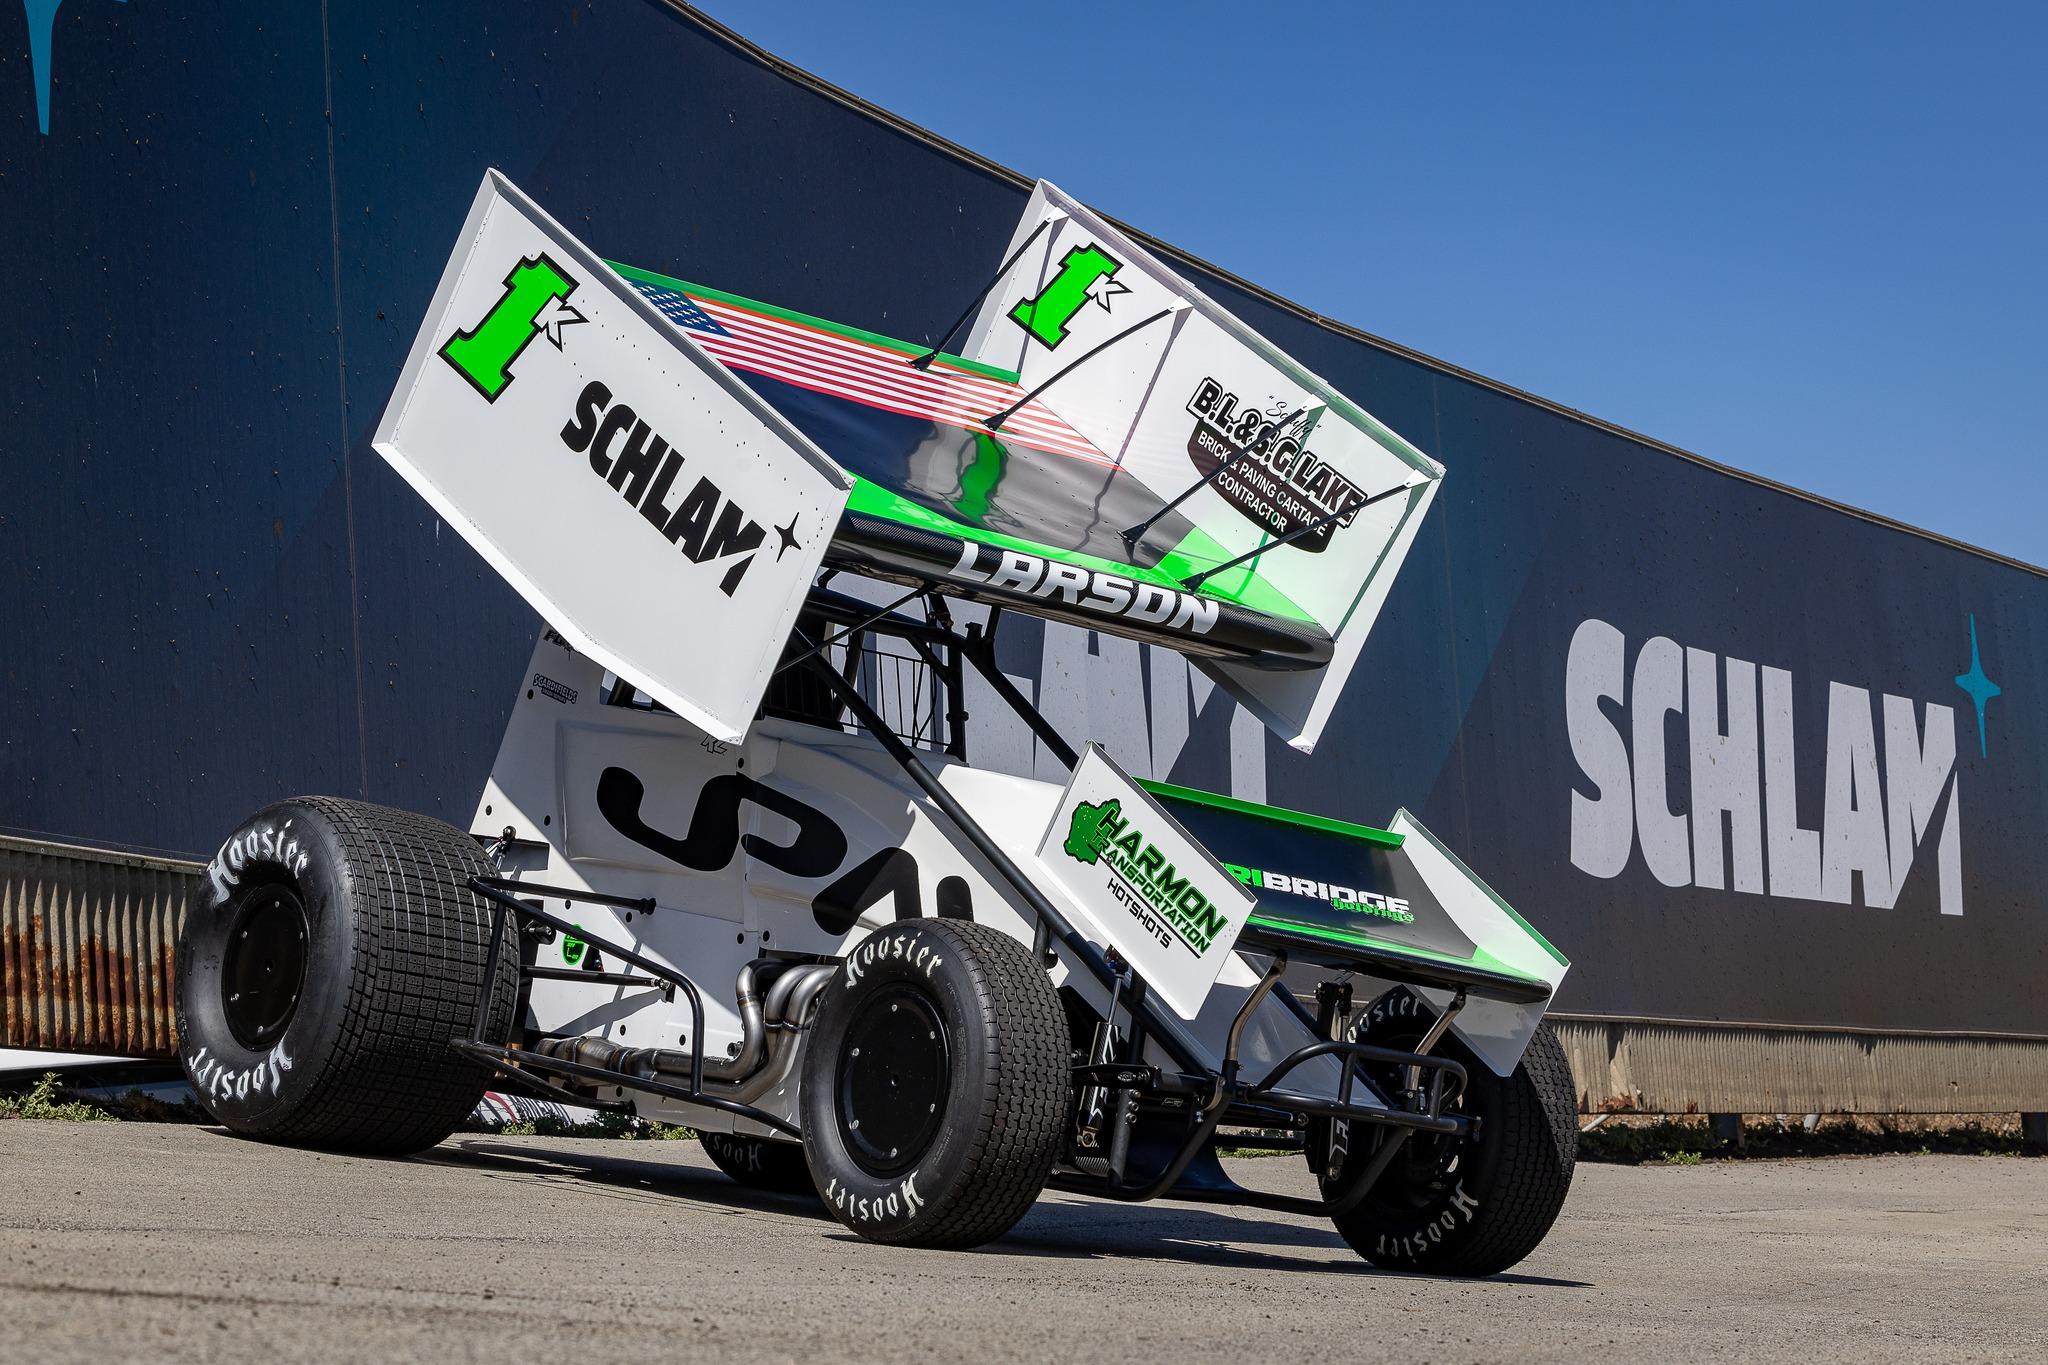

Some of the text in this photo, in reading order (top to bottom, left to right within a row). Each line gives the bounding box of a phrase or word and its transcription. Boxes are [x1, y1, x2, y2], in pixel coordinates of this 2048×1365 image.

[560, 380, 767, 598] SCHLAM
[1197, 430, 1232, 463] BRICK
[1238, 461, 1276, 497] PAVING
[1217, 471, 1288, 533] CONTRACTOR
[947, 540, 1220, 636] LARSON
[1565, 618, 1964, 916] SCHLAM
[206, 818, 309, 905] Hoosier
[1090, 829, 1211, 954] TRANSPORTATION
[1096, 806, 1229, 941] HARMON
[1220, 862, 1410, 913] RIBRIDGE
[1107, 877, 1172, 949] HOTSHOTS
[845, 931, 943, 989] Hoosier
[1347, 995, 1421, 1043] oosier
[186, 1034, 294, 1108] Hoosier
[705, 1132, 764, 1173] Hoos
[826, 1169, 925, 1224] Hoosier
[1376, 1178, 1480, 1264] Hoosier
